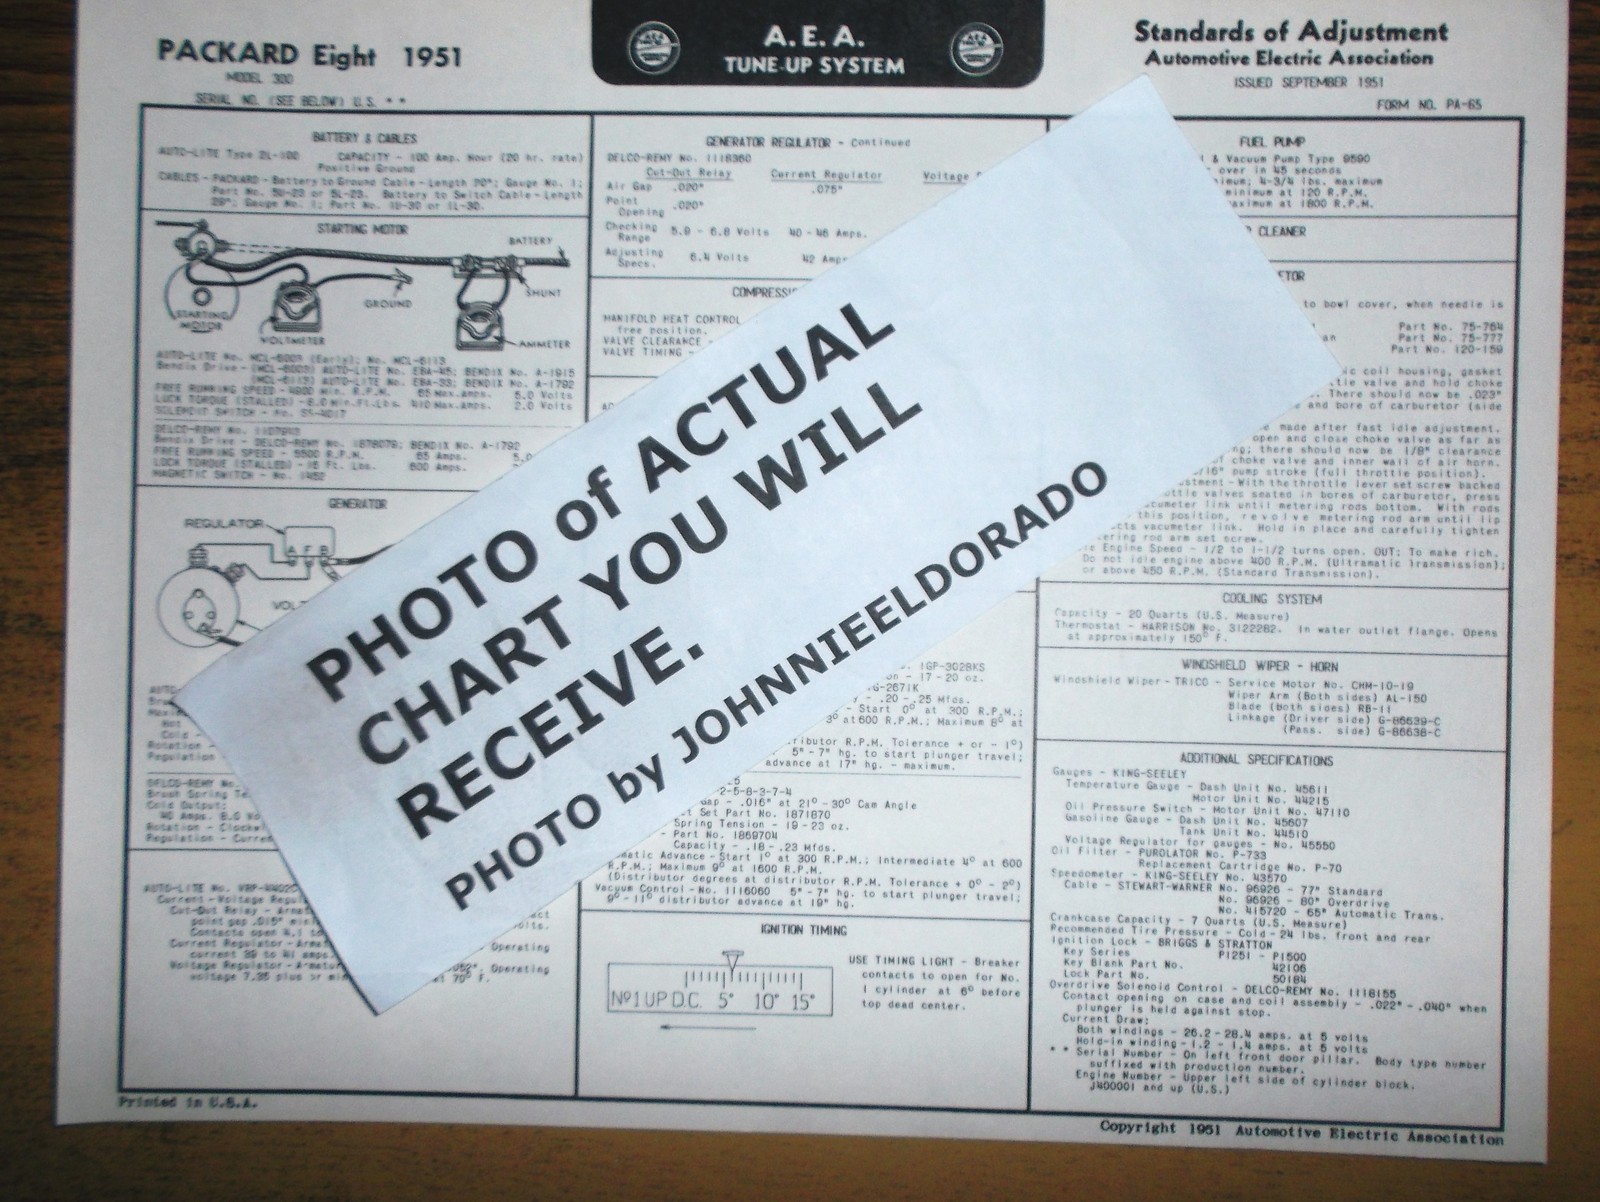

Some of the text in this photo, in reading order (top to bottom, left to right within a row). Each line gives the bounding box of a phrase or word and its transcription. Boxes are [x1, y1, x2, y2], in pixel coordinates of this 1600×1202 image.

[1134, 19, 1448, 45] Standards of Adjustment
[158, 38, 461, 71] PACKARD Eight 1951
[1144, 50, 1434, 66] Automotive Electric Association
[820, 57, 905, 74] SYSTEM
[1234, 76, 1384, 88] ISSUED SEPTEMBER 1951
[1376, 99, 1410, 110] FORM
[1445, 98, 1482, 110] PA-65
[705, 135, 765, 147] GENERATOR
[770, 136, 831, 148] REGULATOR
[850, 138, 910, 147] Continued
[1238, 135, 1306, 147] FUEL PUMP
[1226, 155, 1267, 163] Vacuum
[1272, 154, 1300, 166] Pump
[1308, 153, 1334, 165] Type
[699, 168, 732, 180] Relay
[771, 169, 883, 182] Current Regulator
[923, 171, 968, 182] Voltage
[1279, 188, 1292, 197] at
[1326, 187, 1367, 197] R.P.M.
[316, 222, 408, 235] STARTING MOTOR
[1258, 225, 1306, 237] CLEANER
[526, 288, 562, 298] SHUNT
[662, 314, 689, 323] HEAT
[695, 314, 740, 325] CONTROL
[1398, 332, 1425, 342] Part
[1461, 333, 1503, 342] 75-777
[519, 340, 571, 349] AMMETER
[304, 302, 896, 704] PHOTO of ACTUAL
[329, 498, 387, 509] GENERATOR
[184, 518, 264, 529] REGULATOR
[357, 381, 923, 766] CHART YOU WILL
[1222, 592, 1322, 605] COOLING SYSTEM
[1128, 609, 1142, 619] 20
[1148, 609, 1188, 620] Quarts
[1181, 658, 1246, 671] WINDSHIELD
[1255, 659, 1290, 671] WIPER
[1310, 661, 1338, 672] HORN
[444, 462, 1107, 912] PHOTO by JOHNNIEELDORADO
[1283, 713, 1328, 723] (Driver
[1337, 714, 1370, 724] side)
[395, 626, 705, 840] RECEIVE.
[1180, 752, 1334, 767] ADDITIONAL SPECIFICATIONS
[1112, 768, 1186, 779] KING-SEELEY
[699, 807, 718, 817] Set
[725, 808, 750, 817] Part
[1138, 859, 1211, 871] Replacement
[1218, 861, 1280, 872] Cartridge
[1064, 879, 1098, 889] Cable
[1118, 880, 1212, 892] STEWART-WARNER
[1328, 886, 1383, 897] Standard
[760, 923, 847, 936] IGNITION TIMING
[848, 954, 868, 965] USE
[875, 955, 915, 965] TIMING
[921, 956, 954, 967] LIGHT
[974, 957, 1019, 967] Breaker
[1063, 958, 1083, 970] Key
[1090, 958, 1123, 968] Blank
[1130, 958, 1157, 968] Part
[861, 970, 914, 979] contacts
[922, 971, 934, 980] to
[940, 973, 967, 984] open
[975, 972, 993, 982] for
[875, 985, 927, 997] cylinder
[938, 986, 950, 995] at
[981, 988, 1020, 997] before
[862, 1000, 965, 1012] top dead center.
[186, 1096, 203, 1108] in
[1099, 1119, 1504, 1146] Copyright 1951 Automotive Electric Association
